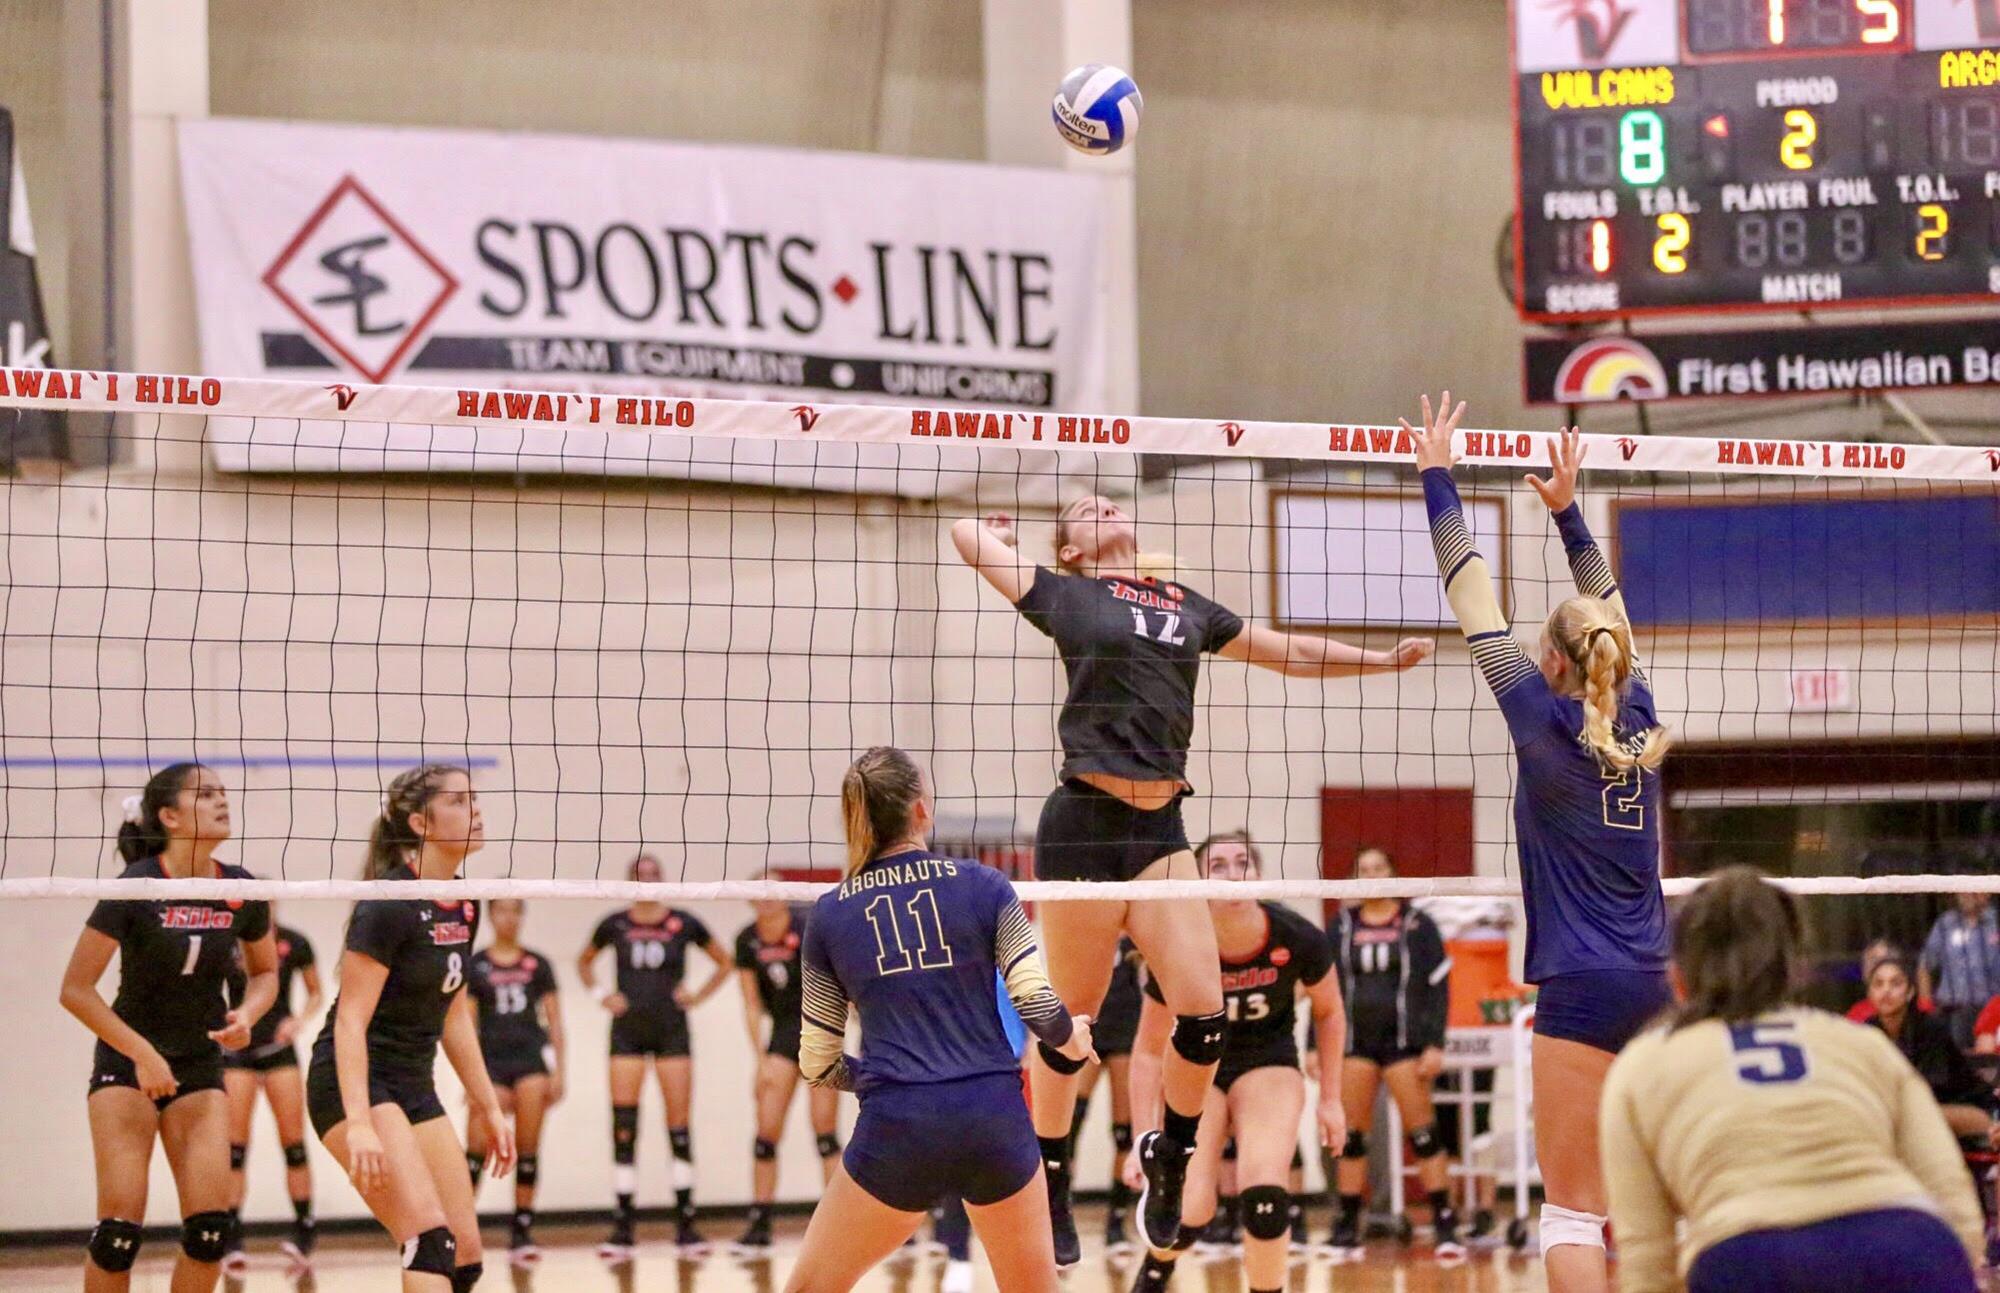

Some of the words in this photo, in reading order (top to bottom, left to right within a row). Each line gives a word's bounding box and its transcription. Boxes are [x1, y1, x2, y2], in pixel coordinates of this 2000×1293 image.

[1542, 66, 1675, 109] VULCANS
[1940, 49, 2000, 89] ARG
[1755, 76, 1838, 108] PERIOD
[1057, 102, 1097, 135] molten
[1619, 110, 1665, 184] 8
[1780, 109, 1817, 170] 2
[1543, 189, 1618, 220] FOULS
[1721, 181, 1809, 212] PLAYER
[1818, 178, 1877, 207] FOUL
[1653, 212, 1691, 273] 2
[1915, 204, 1949, 260] 2
[474, 217, 826, 336] SPORTS
[870, 242, 1059, 352] LINE
[1761, 273, 1842, 304] MATCH
[506, 338, 611, 373] TEAM
[1678, 355, 1769, 396] First
[1776, 350, 1953, 392] Hawaiian
[135, 375, 222, 406] HILO
[616, 399, 695, 428] HILO
[1057, 416, 1131, 444] HILO
[1329, 427, 1424, 454] HAWA
[1465, 432, 1532, 458] HILO
[1842, 445, 1906, 470] HILO
[1601, 762, 1643, 830] 2
[838, 859, 958, 901] ARGONAUTS
[159, 906, 234, 929] Hilo
[864, 888, 953, 976] 11
[181, 935, 202, 975] 1
[441, 952, 463, 994] 8
[1226, 992, 1270, 1022] 13
[1726, 1022, 1808, 1085] 5
